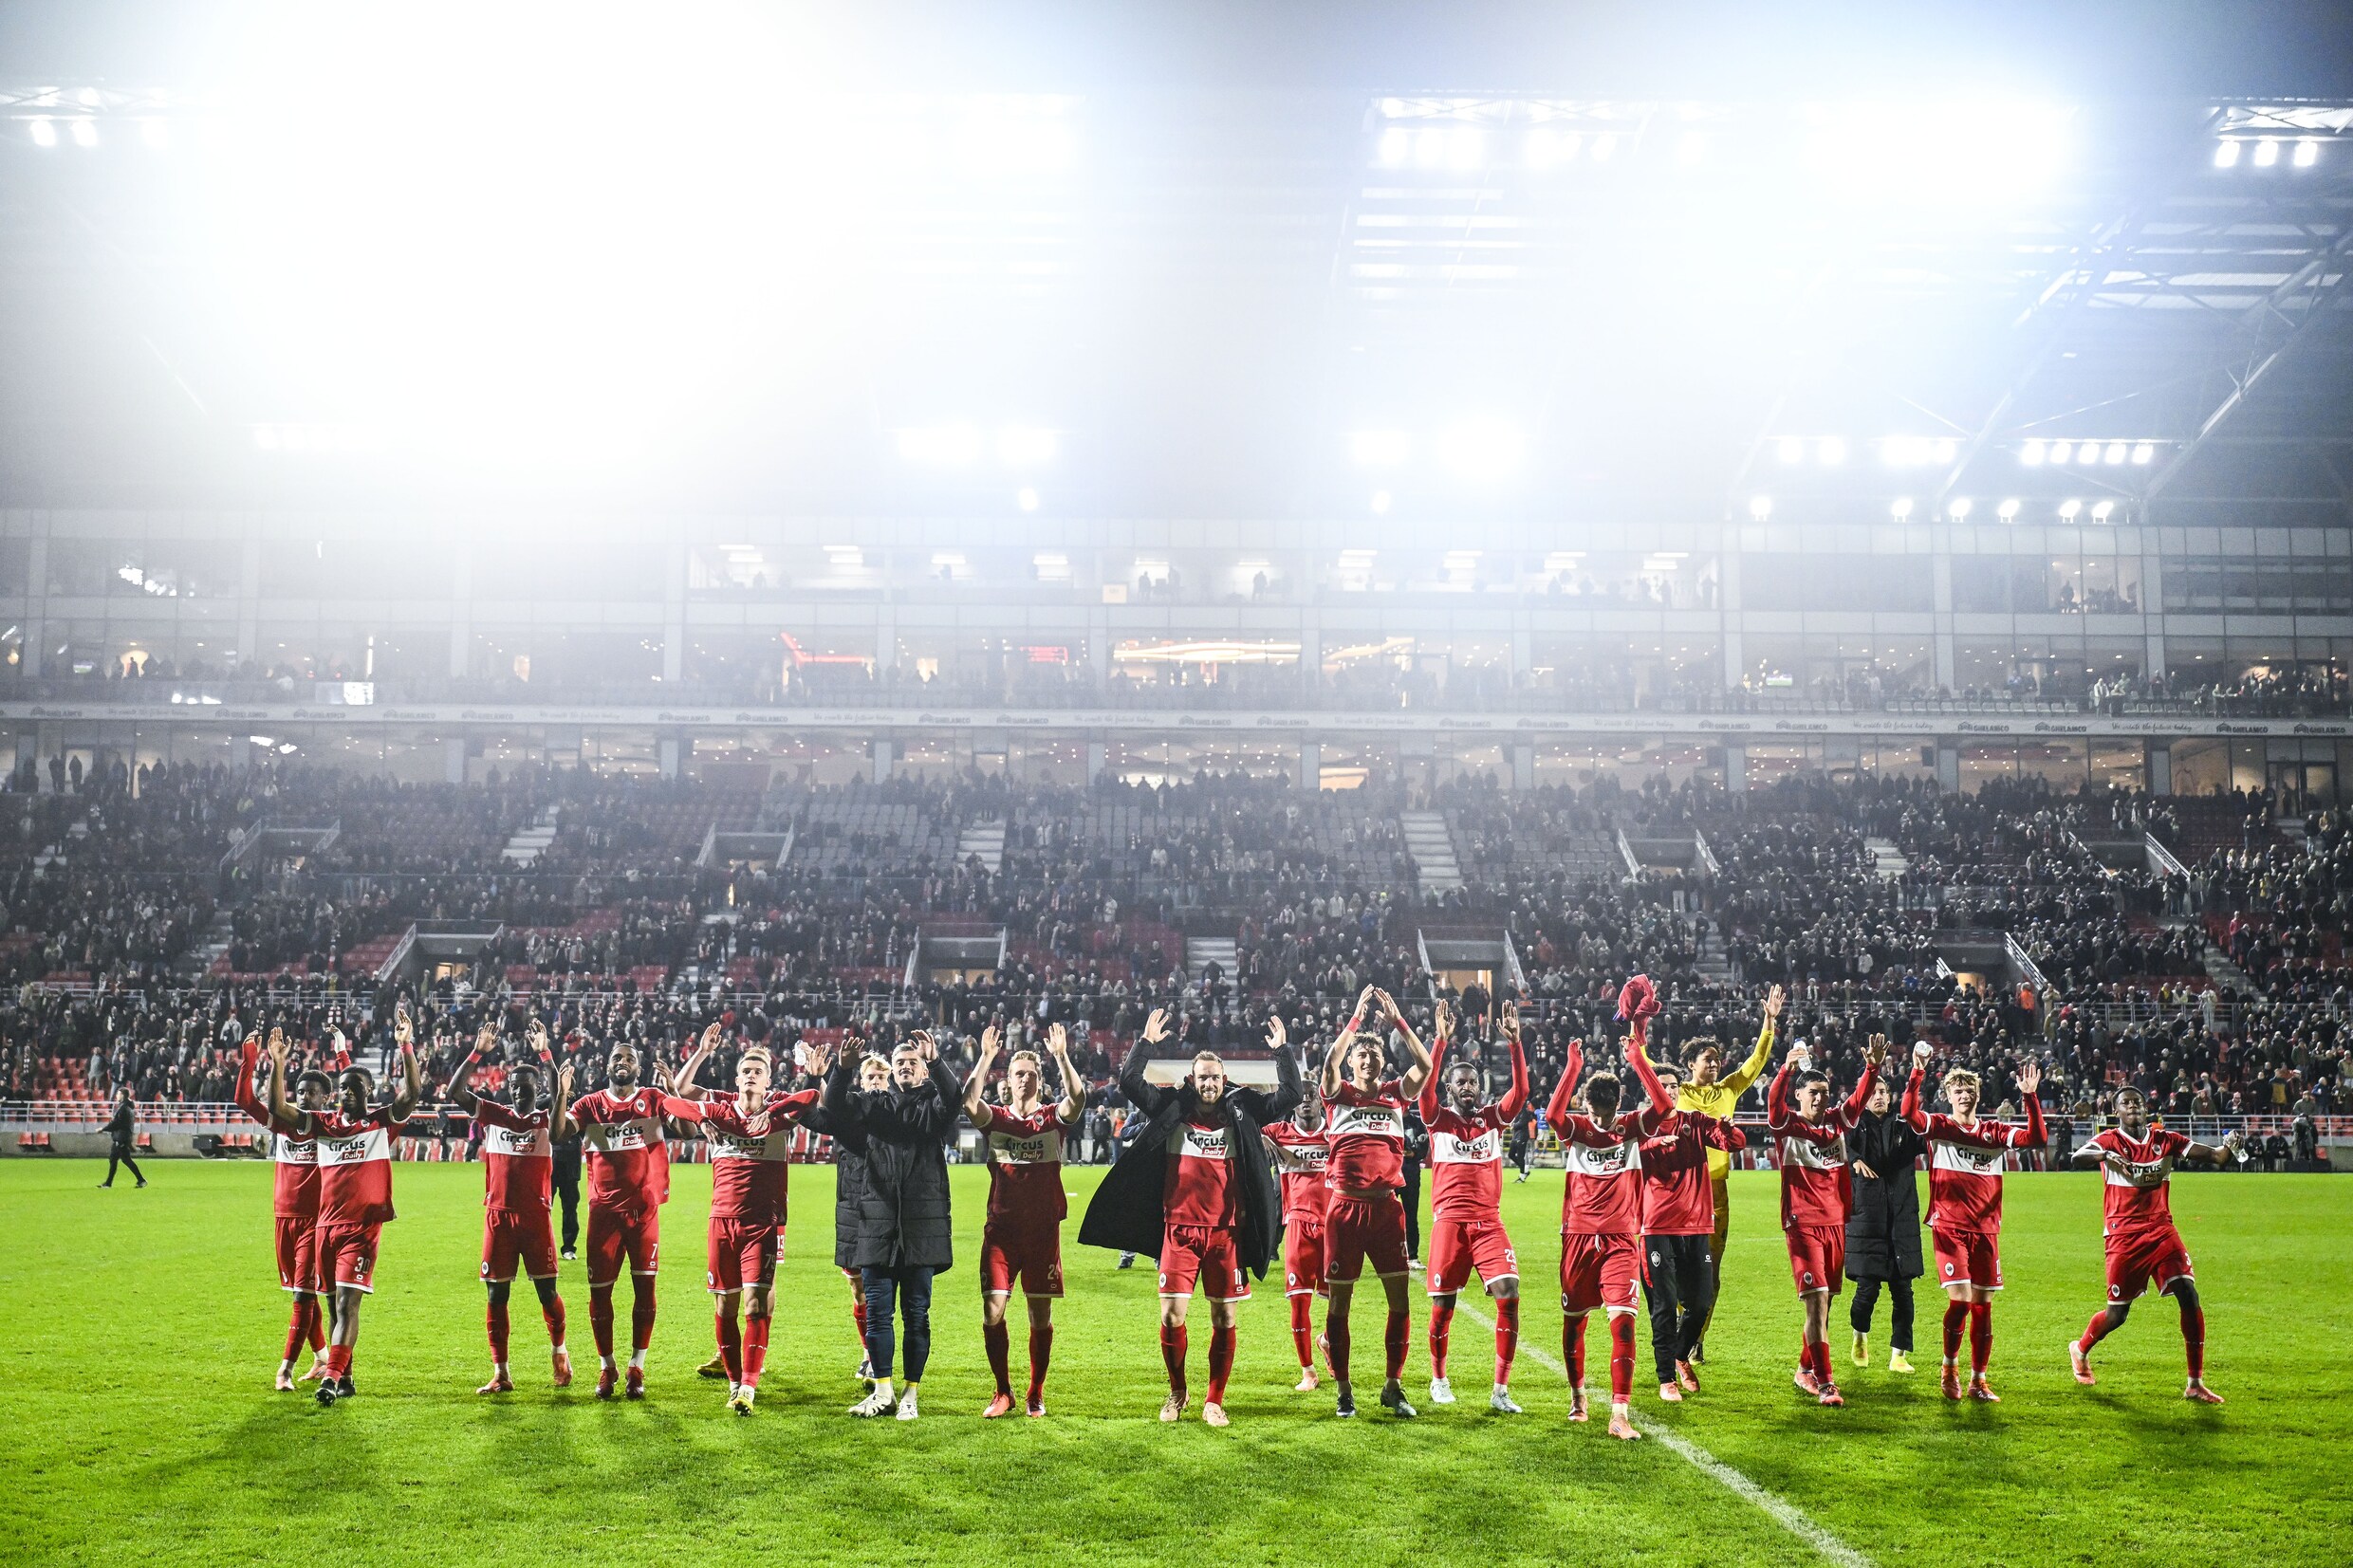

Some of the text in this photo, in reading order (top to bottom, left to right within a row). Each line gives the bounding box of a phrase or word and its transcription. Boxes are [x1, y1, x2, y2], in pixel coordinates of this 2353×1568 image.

[1352, 1110, 1392, 1121] Circus
[500, 1131, 536, 1144] Circus
[605, 1125, 643, 1138] Circus
[329, 1139, 365, 1151] Circus
[625, 1137, 642, 1145] Daily
[1187, 1132, 1226, 1146] Circus
[1456, 1139, 1488, 1151] Circus
[344, 1151, 362, 1159] Daily
[1023, 1151, 1041, 1160] Daily
[1293, 1149, 1329, 1159] Circus
[1587, 1149, 1625, 1162] Circus
[1957, 1147, 1993, 1162] Circus
[1975, 1163, 1990, 1172] Daily
[548, 1247, 554, 1261] 9
[651, 1244, 658, 1259] 7
[355, 1257, 371, 1274] 30
